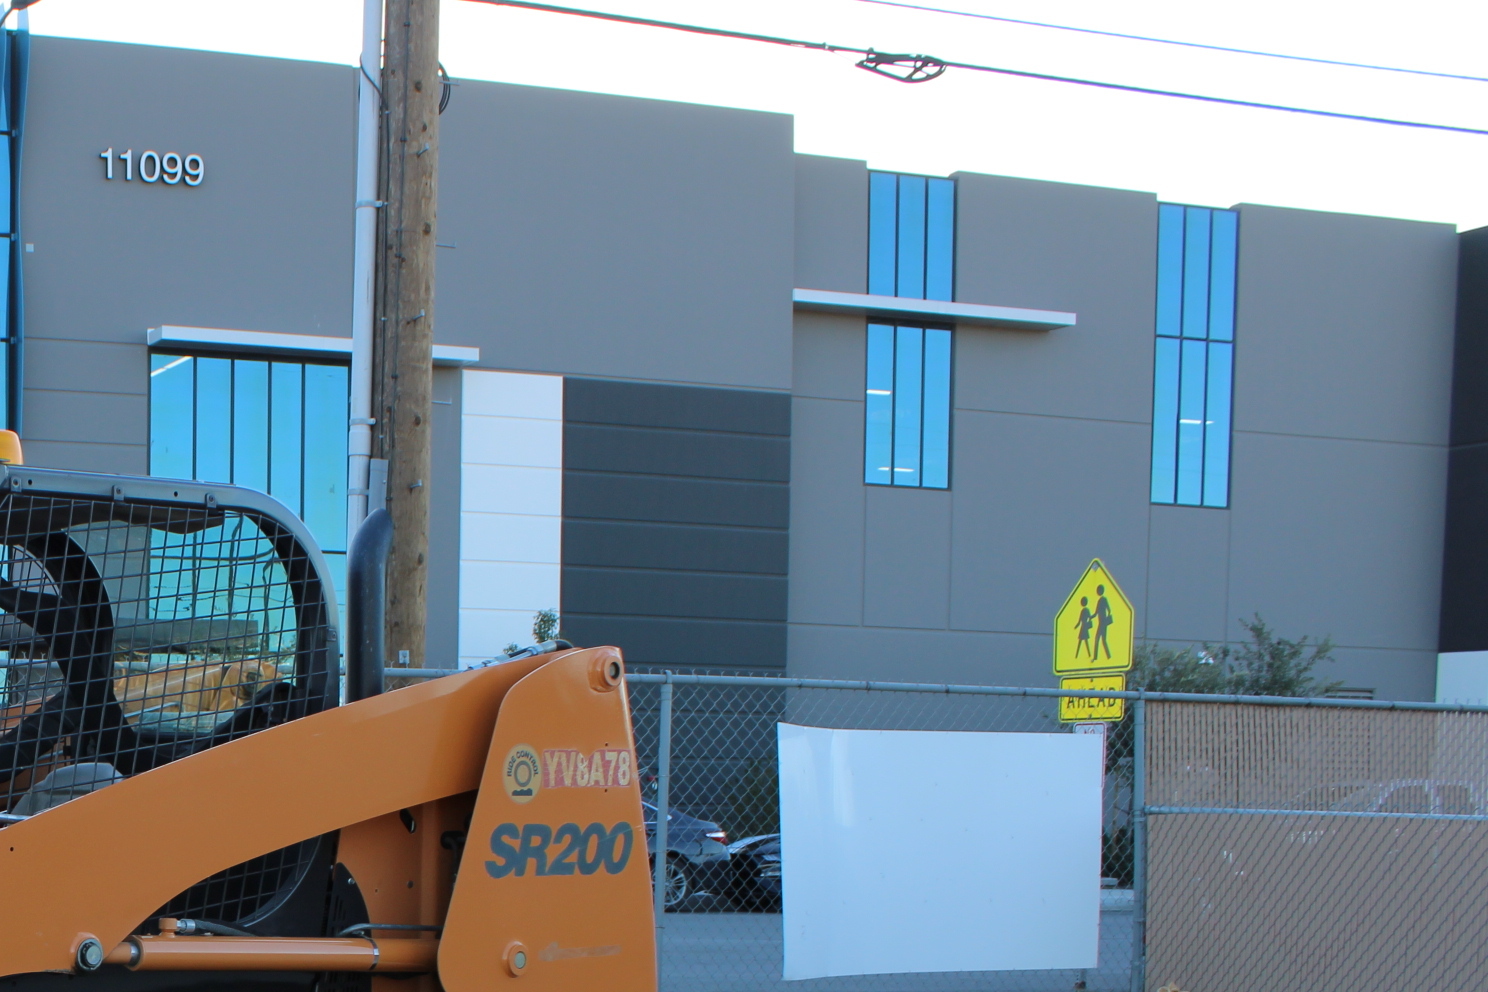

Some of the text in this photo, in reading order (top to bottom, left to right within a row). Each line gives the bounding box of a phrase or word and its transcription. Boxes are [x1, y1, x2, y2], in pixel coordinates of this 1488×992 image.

[99, 147, 205, 186] 11099
[1066, 687, 1116, 709] AHEAD
[516, 750, 539, 777] CONTROL
[544, 750, 631, 787] YV8A78
[485, 822, 633, 879] SR200
